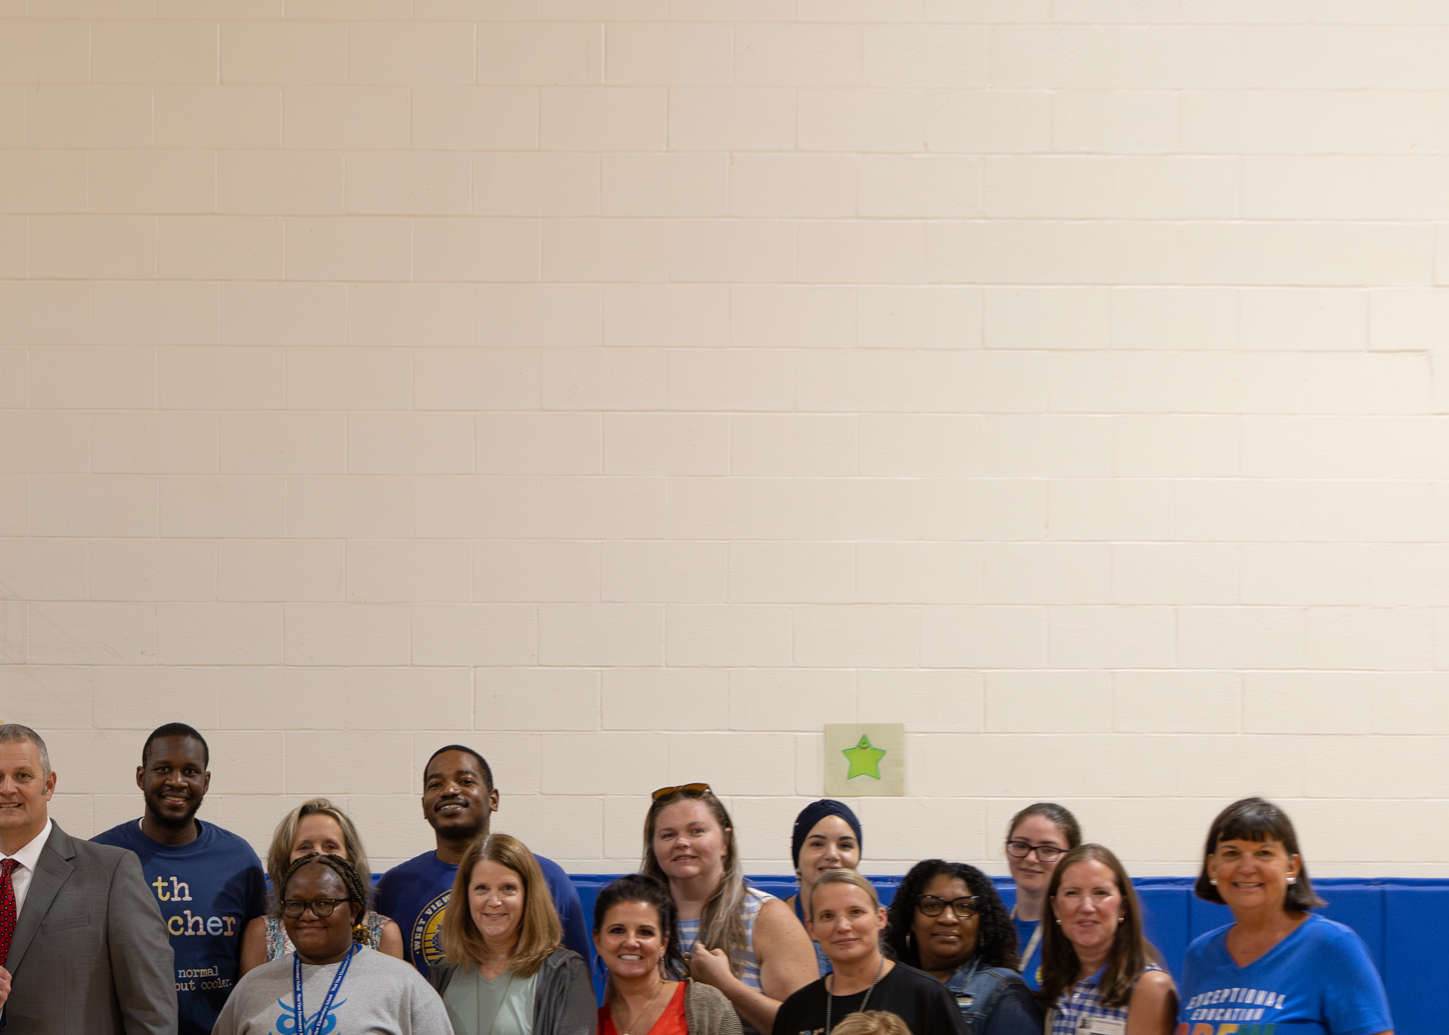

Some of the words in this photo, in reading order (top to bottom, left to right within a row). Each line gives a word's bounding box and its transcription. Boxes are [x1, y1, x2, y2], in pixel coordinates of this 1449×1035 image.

[152, 876, 193, 902] th
[167, 909, 237, 937] cher
[413, 918, 426, 952] WEST
[177, 965, 220, 979] normal
